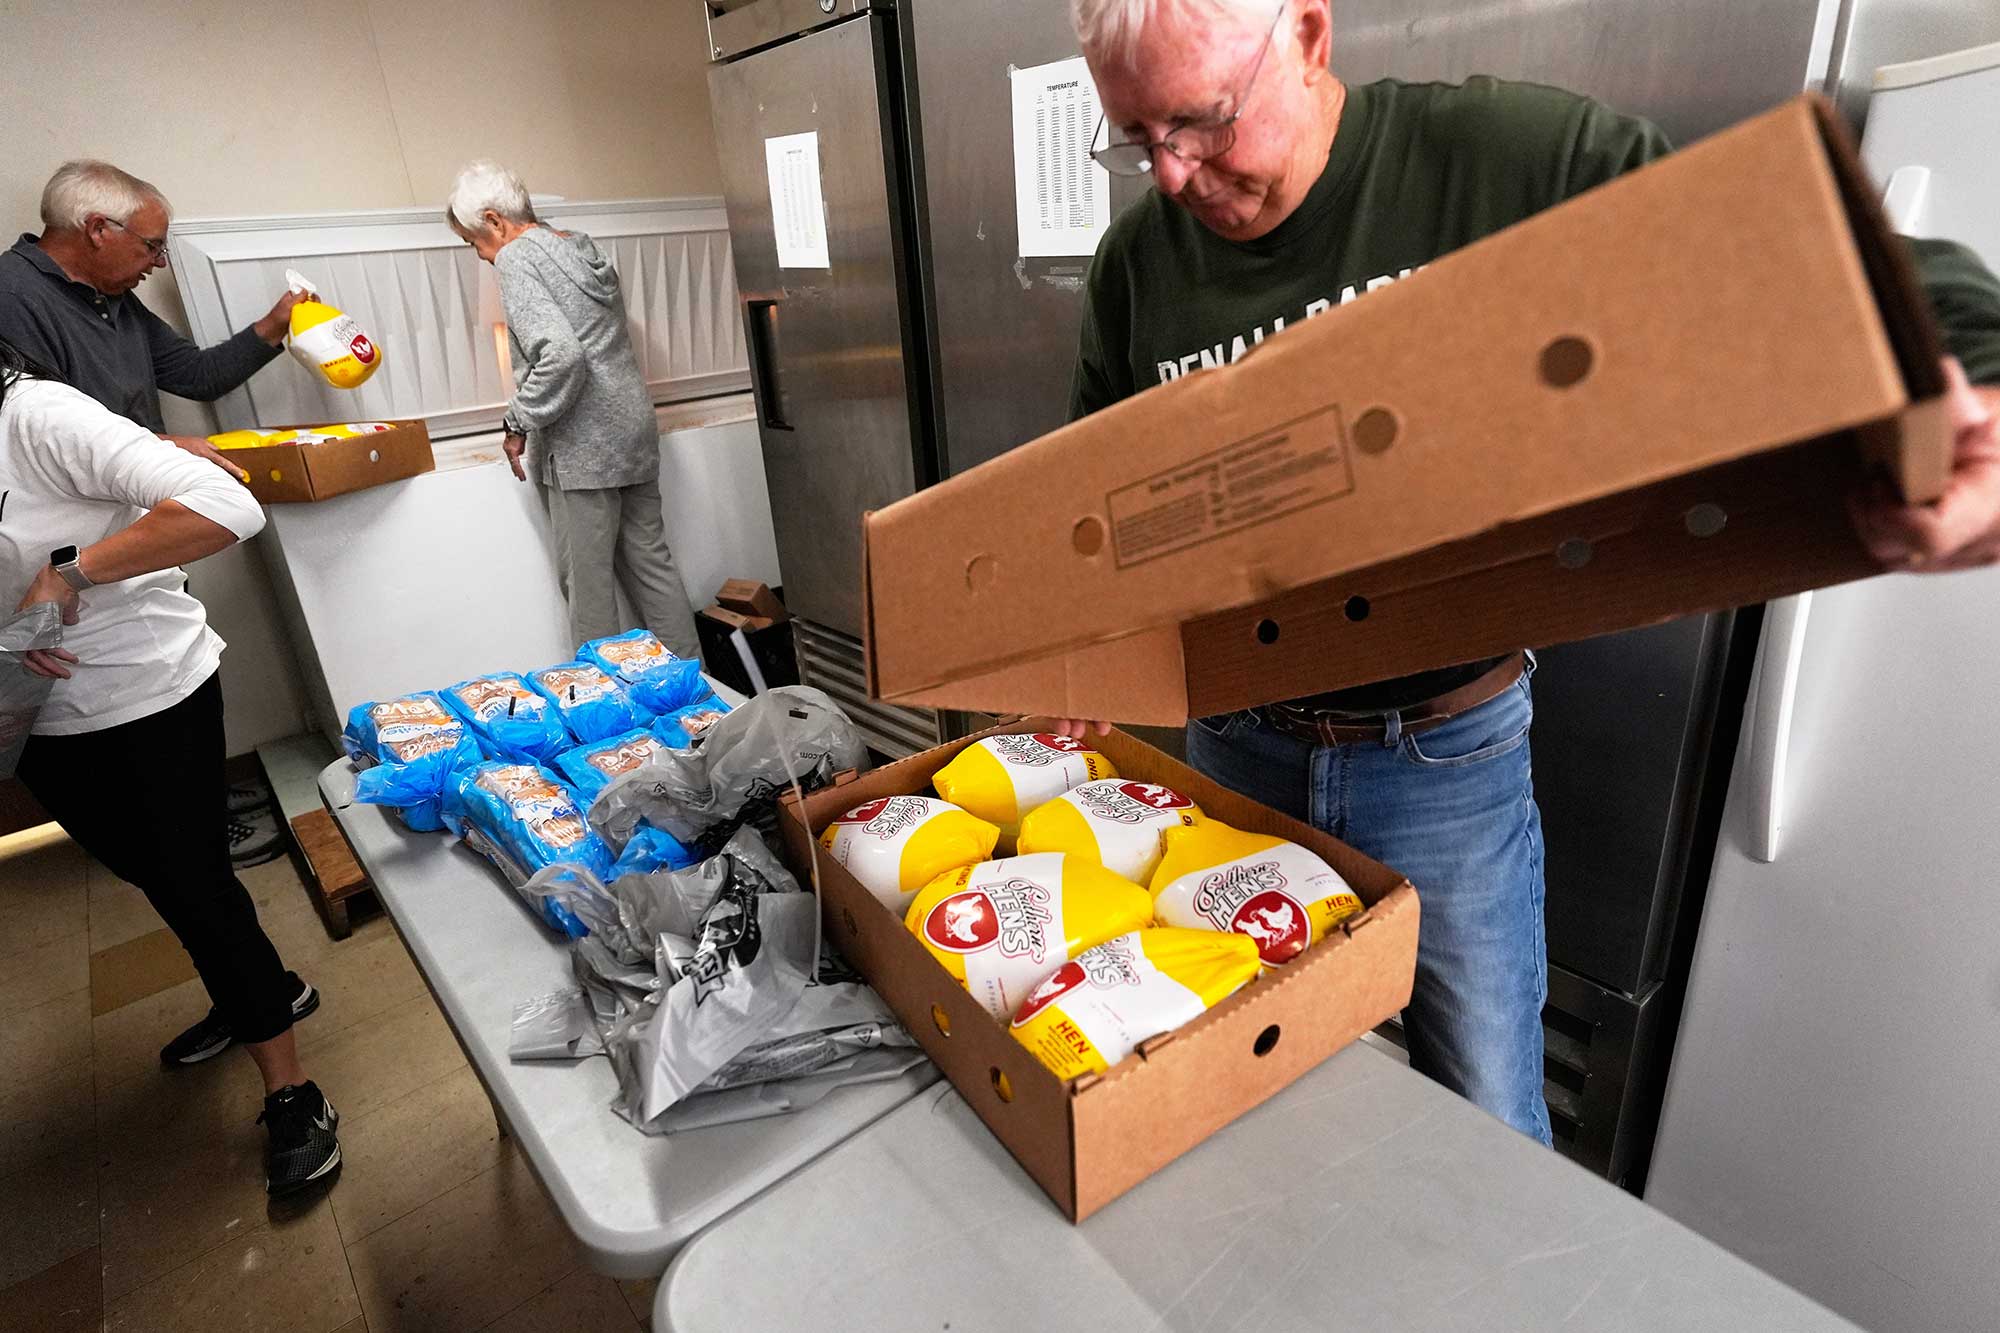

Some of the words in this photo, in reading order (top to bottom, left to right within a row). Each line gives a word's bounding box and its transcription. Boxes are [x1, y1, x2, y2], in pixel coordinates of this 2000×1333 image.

[1046, 80, 1078, 92] TEMPERATURE
[1197, 862, 1279, 912] Southern
[1211, 871, 1283, 928] HENS
[1325, 895, 1354, 911] HEN
[984, 883, 1030, 953] HENS
[1008, 879, 1051, 962] Southern
[1056, 1021, 1091, 1054] HEN
